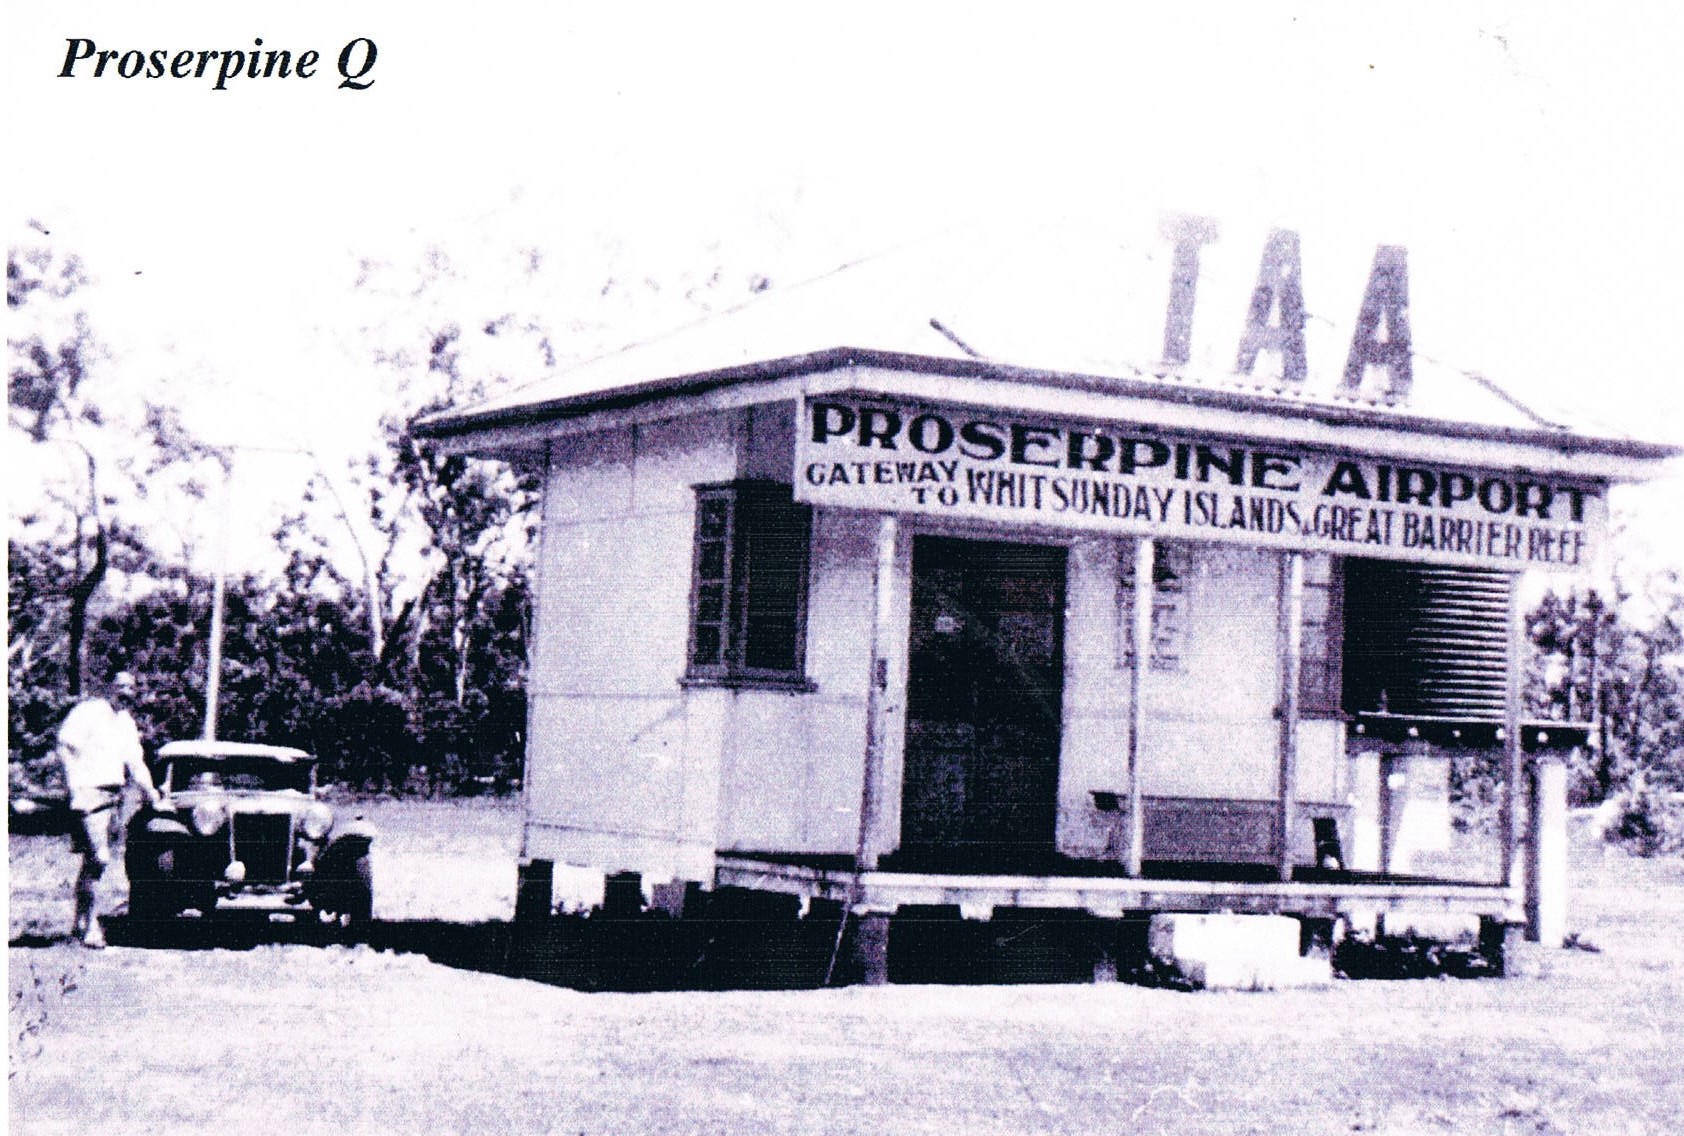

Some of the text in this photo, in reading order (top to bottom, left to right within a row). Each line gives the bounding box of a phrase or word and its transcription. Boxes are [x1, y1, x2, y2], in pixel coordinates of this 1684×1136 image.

[1160, 211, 1412, 393] TAA
[806, 460, 958, 485] GATEWAY
[811, 402, 1602, 523] PROSERPINE AIRPORT
[911, 486, 958, 506] TO
[967, 468, 1175, 524] WHITSUNDAY
[1313, 504, 1393, 545] GREAT
[1403, 512, 1522, 559] BARRIER
[1527, 527, 1586, 565] REEF
